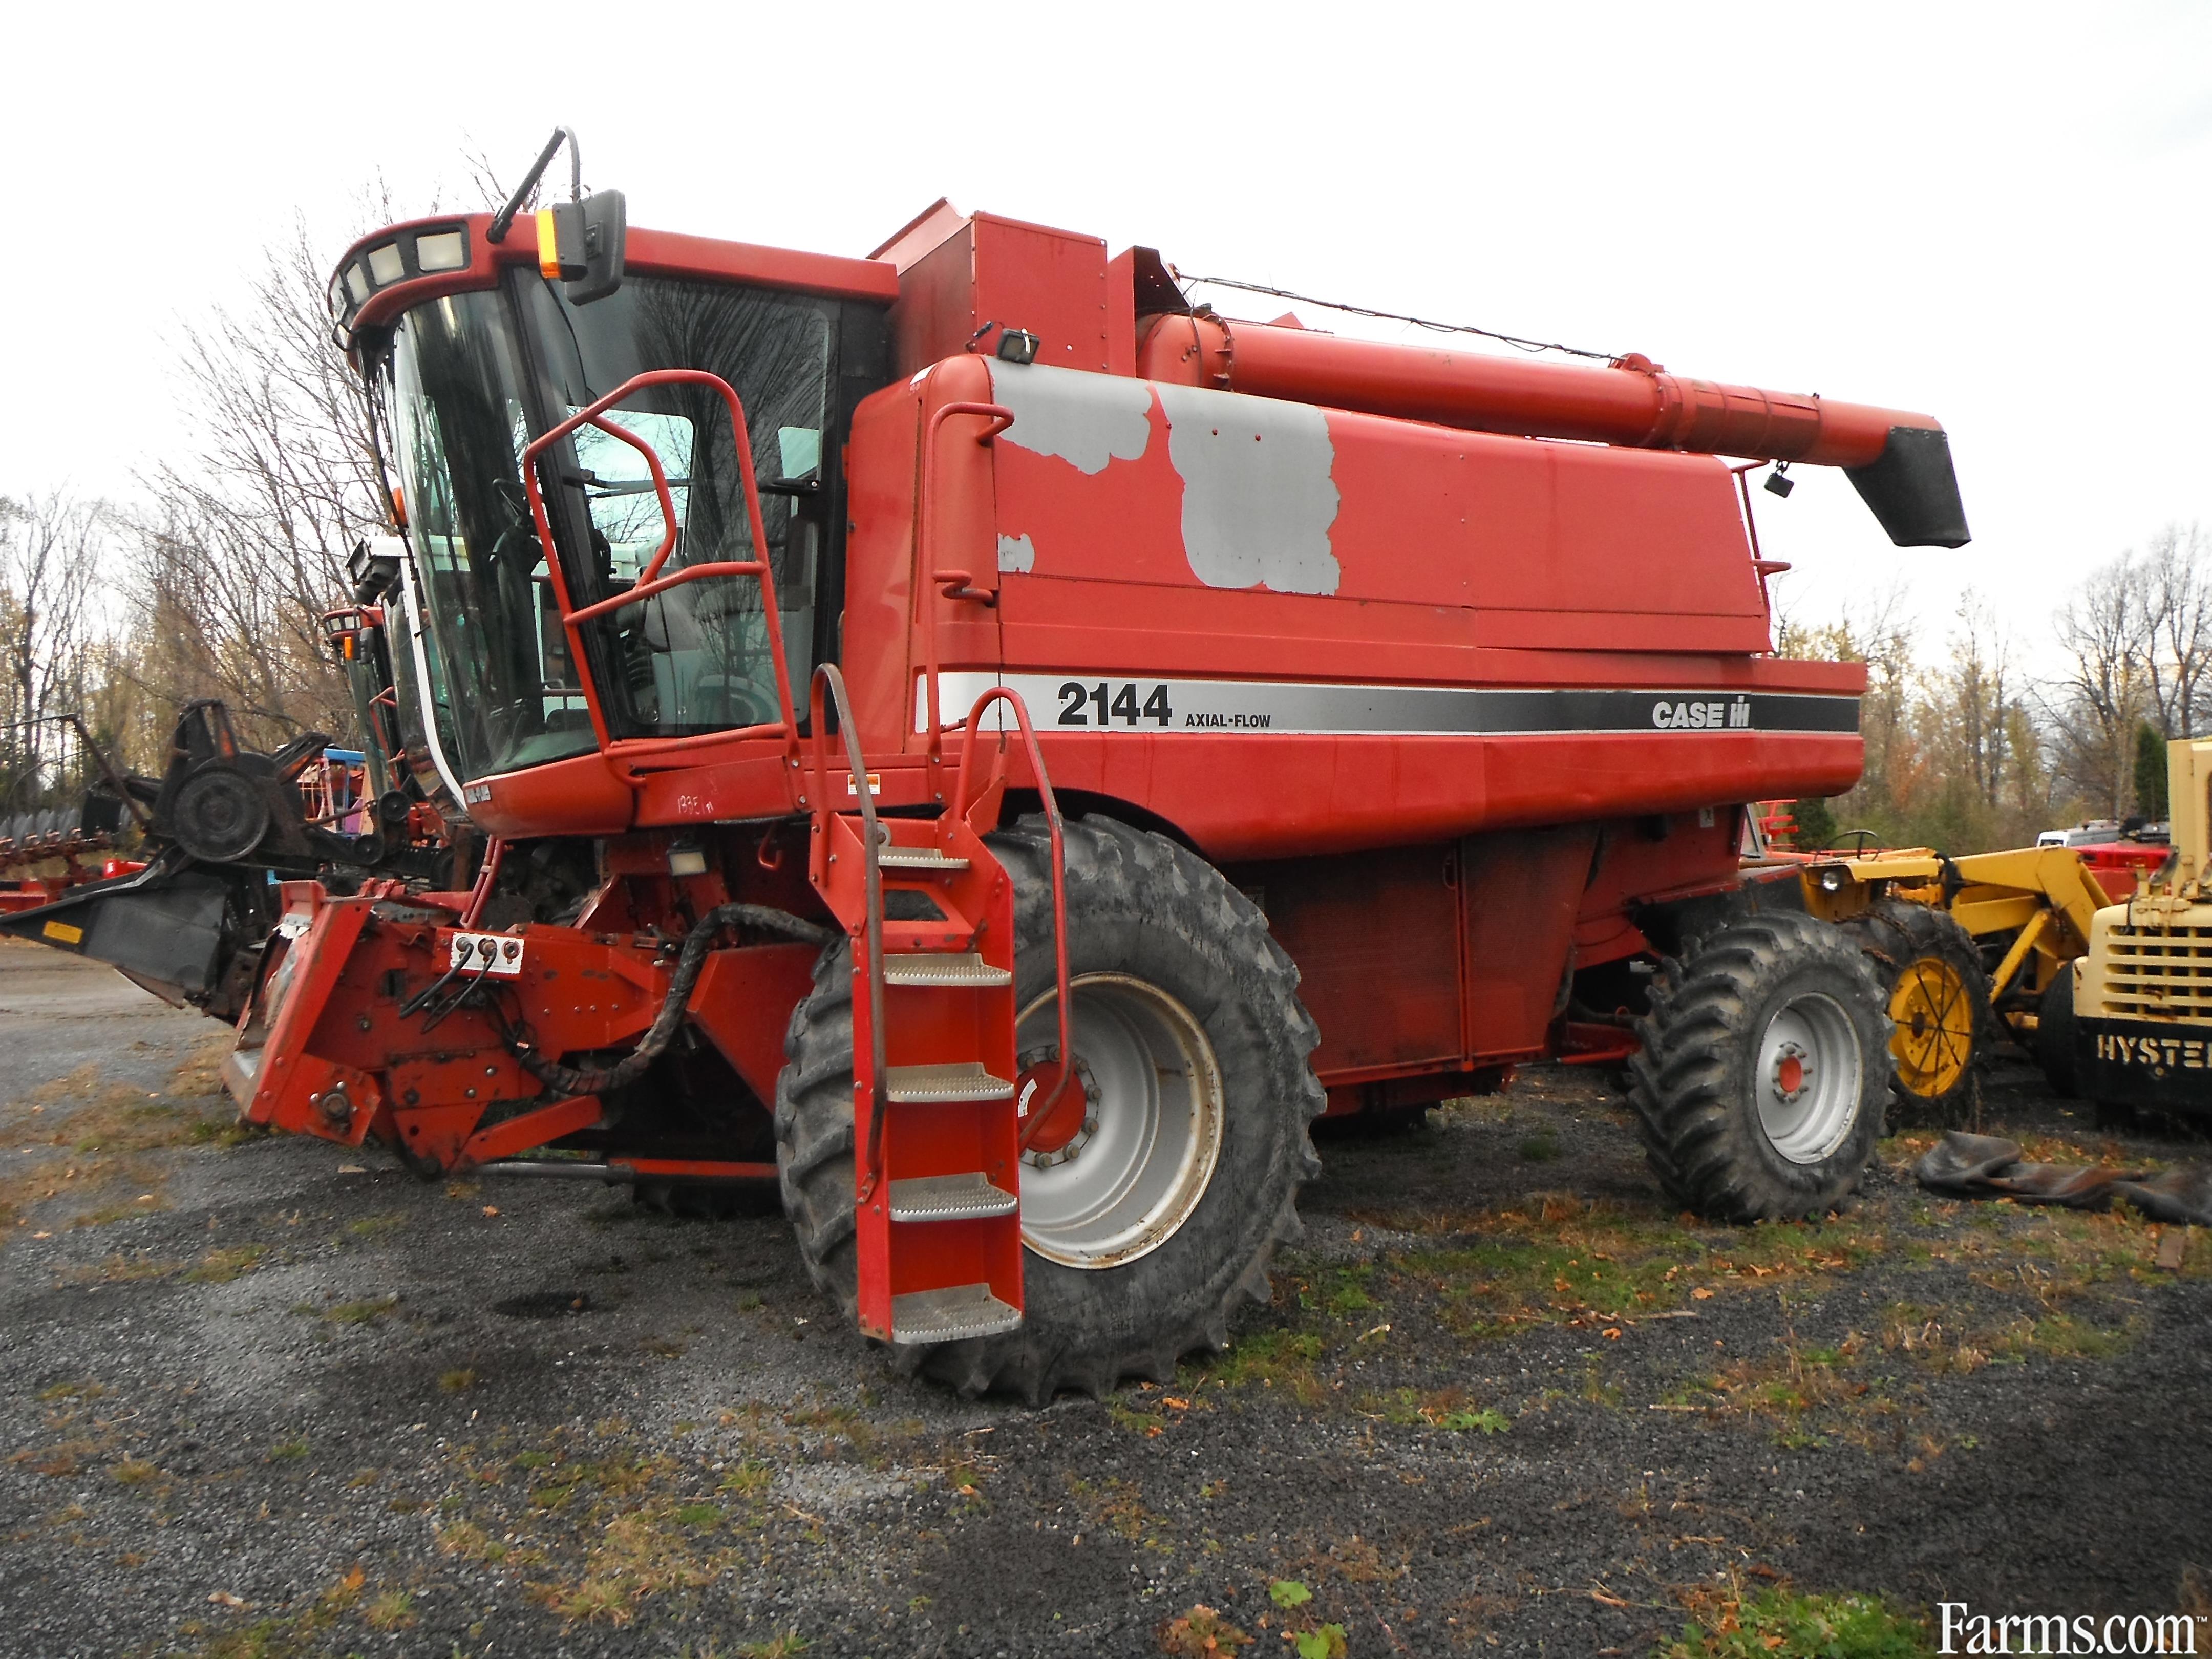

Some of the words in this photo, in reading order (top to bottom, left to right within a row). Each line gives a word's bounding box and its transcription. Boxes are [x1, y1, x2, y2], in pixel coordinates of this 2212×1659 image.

[1058, 682, 1172, 726] 2144
[1185, 714, 1271, 727] AXIAL-FLOW
[1653, 701, 1724, 728] CASE
